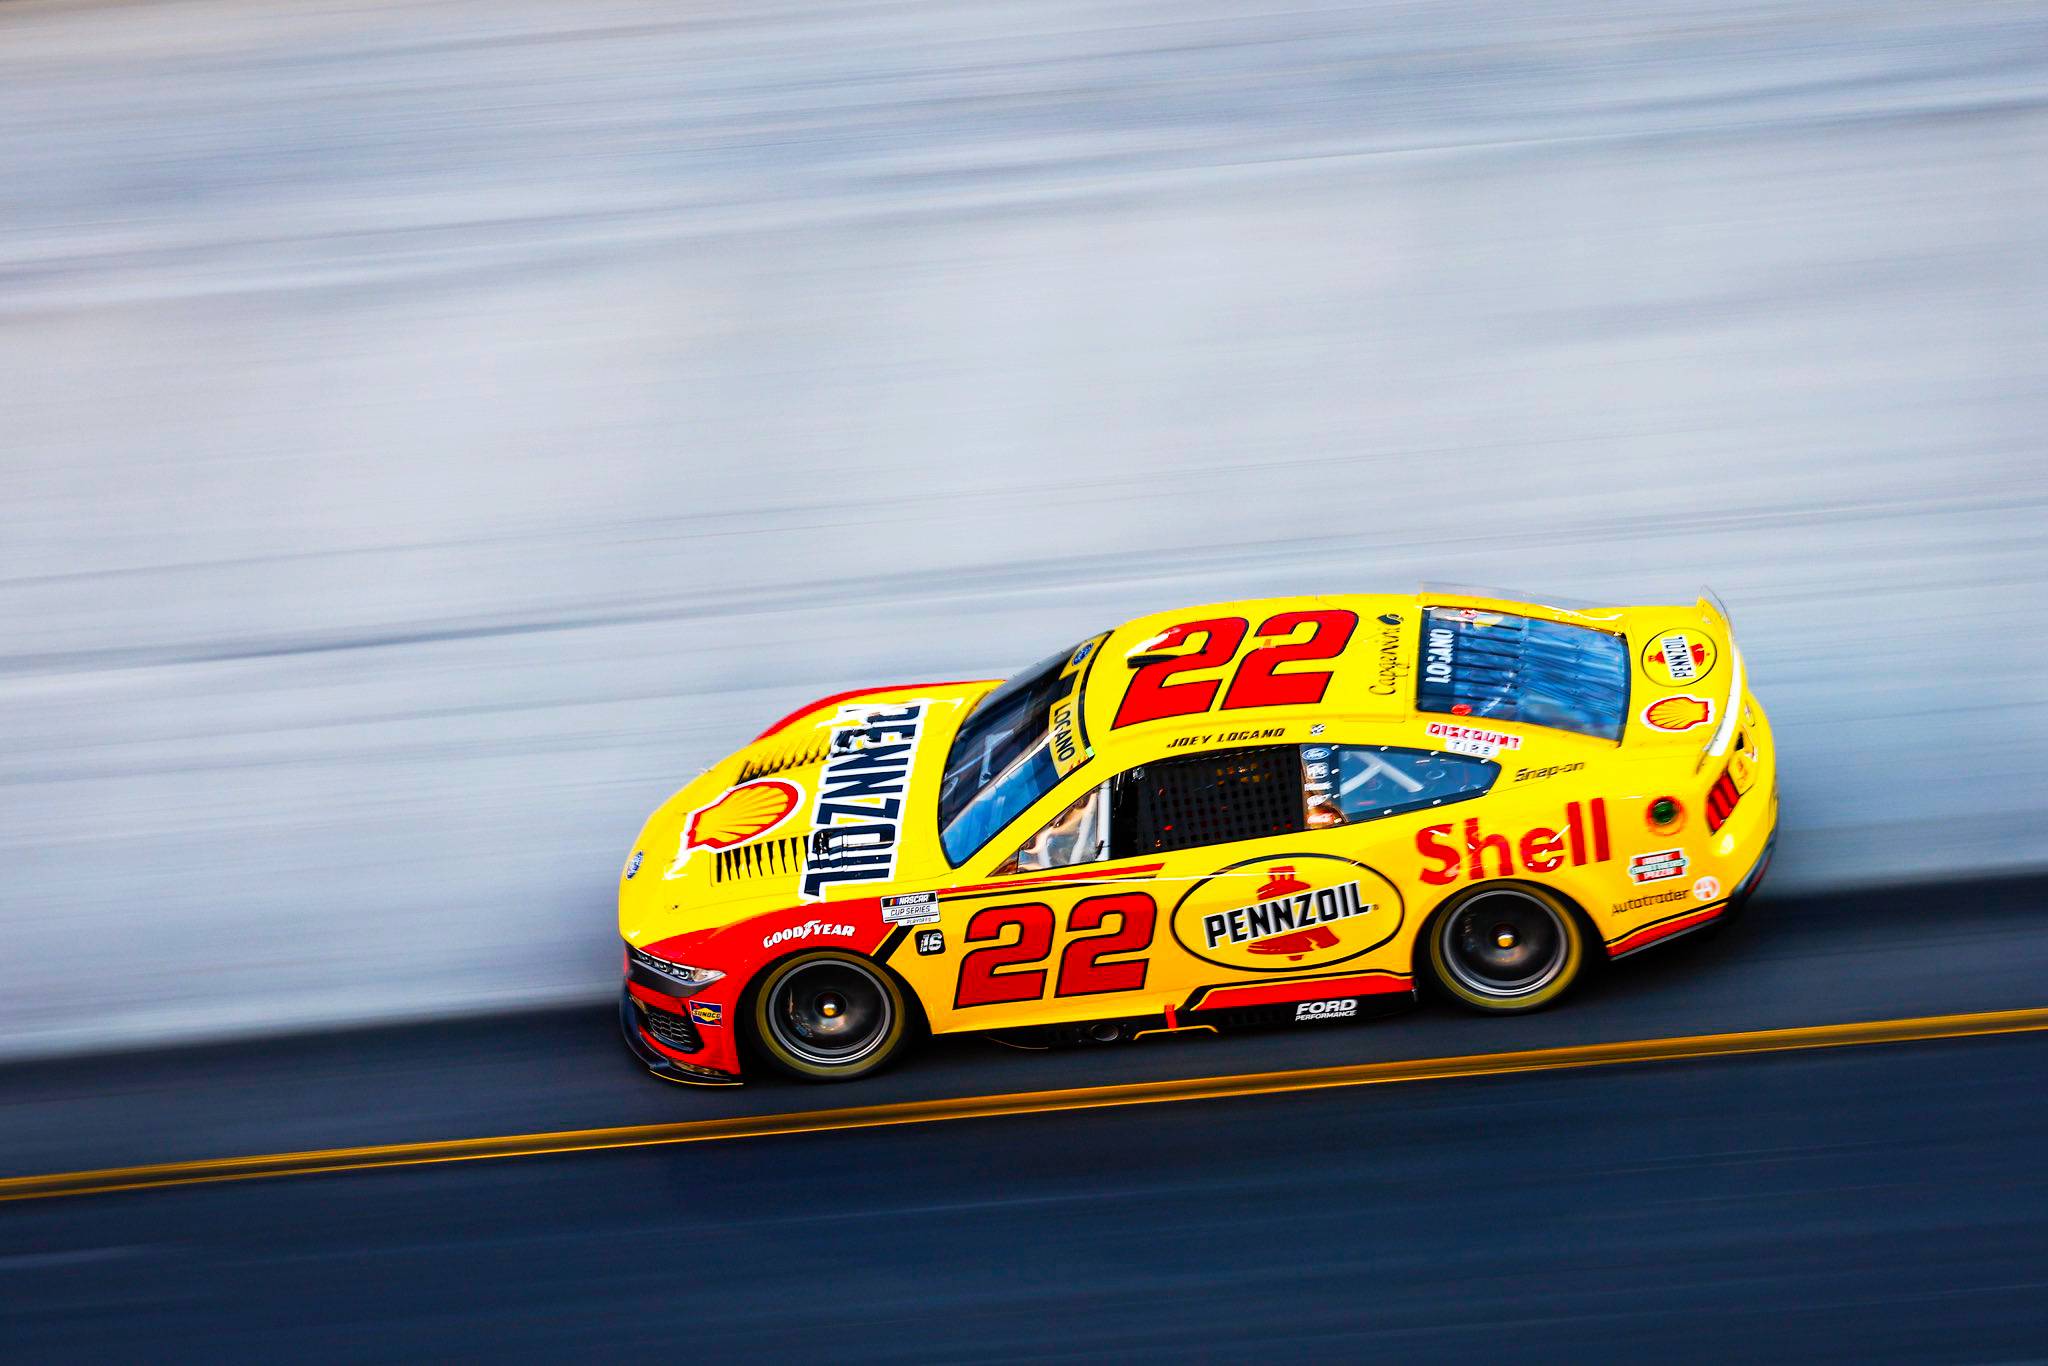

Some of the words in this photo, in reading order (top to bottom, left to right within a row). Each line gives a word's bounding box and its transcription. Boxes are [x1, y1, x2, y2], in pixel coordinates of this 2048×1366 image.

[1425, 628, 1455, 684] LOGANO
[1110, 609, 1360, 731] 22
[1054, 702, 1076, 763] LOGANO
[1167, 734, 1212, 749] JOEY
[1217, 727, 1286, 743] LOGANO
[1428, 722, 1521, 748] DISCOUNT
[1451, 740, 1493, 756] TIRE
[1513, 760, 1585, 783] Snap-on
[1415, 797, 1611, 886] Shell
[891, 909, 905, 917] CUP
[906, 905, 931, 915] SERIES
[898, 894, 930, 905] NASCAR
[1611, 889, 1690, 916] Autotrader
[1203, 880, 1371, 950] PENNZOIL
[763, 920, 856, 948] GOODYEAR
[922, 932, 943, 953] 16
[952, 891, 1157, 1010] 22
[1295, 1010, 1358, 1021] PERFORMANCE
[1296, 999, 1358, 1015] FORD
